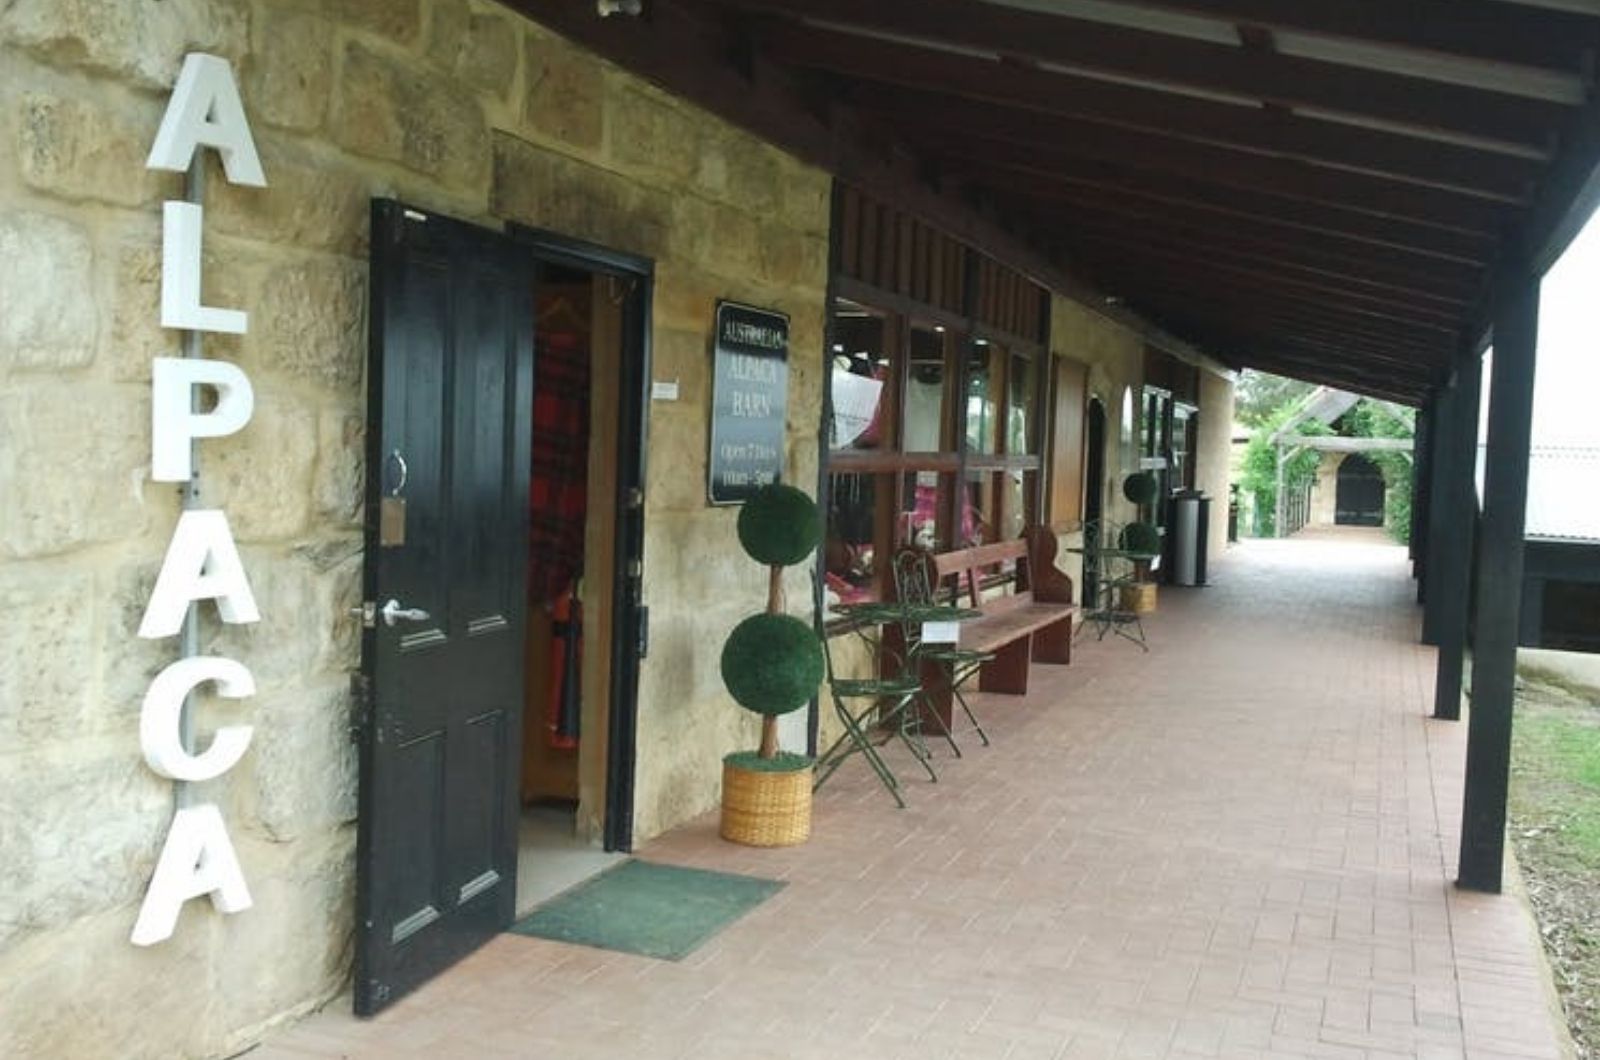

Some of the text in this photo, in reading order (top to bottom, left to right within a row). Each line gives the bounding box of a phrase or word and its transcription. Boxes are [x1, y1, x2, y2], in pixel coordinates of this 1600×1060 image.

[728, 353, 777, 385] ALPACA
[731, 389, 771, 418] BARN
[131, 52, 267, 947] ALPACA
